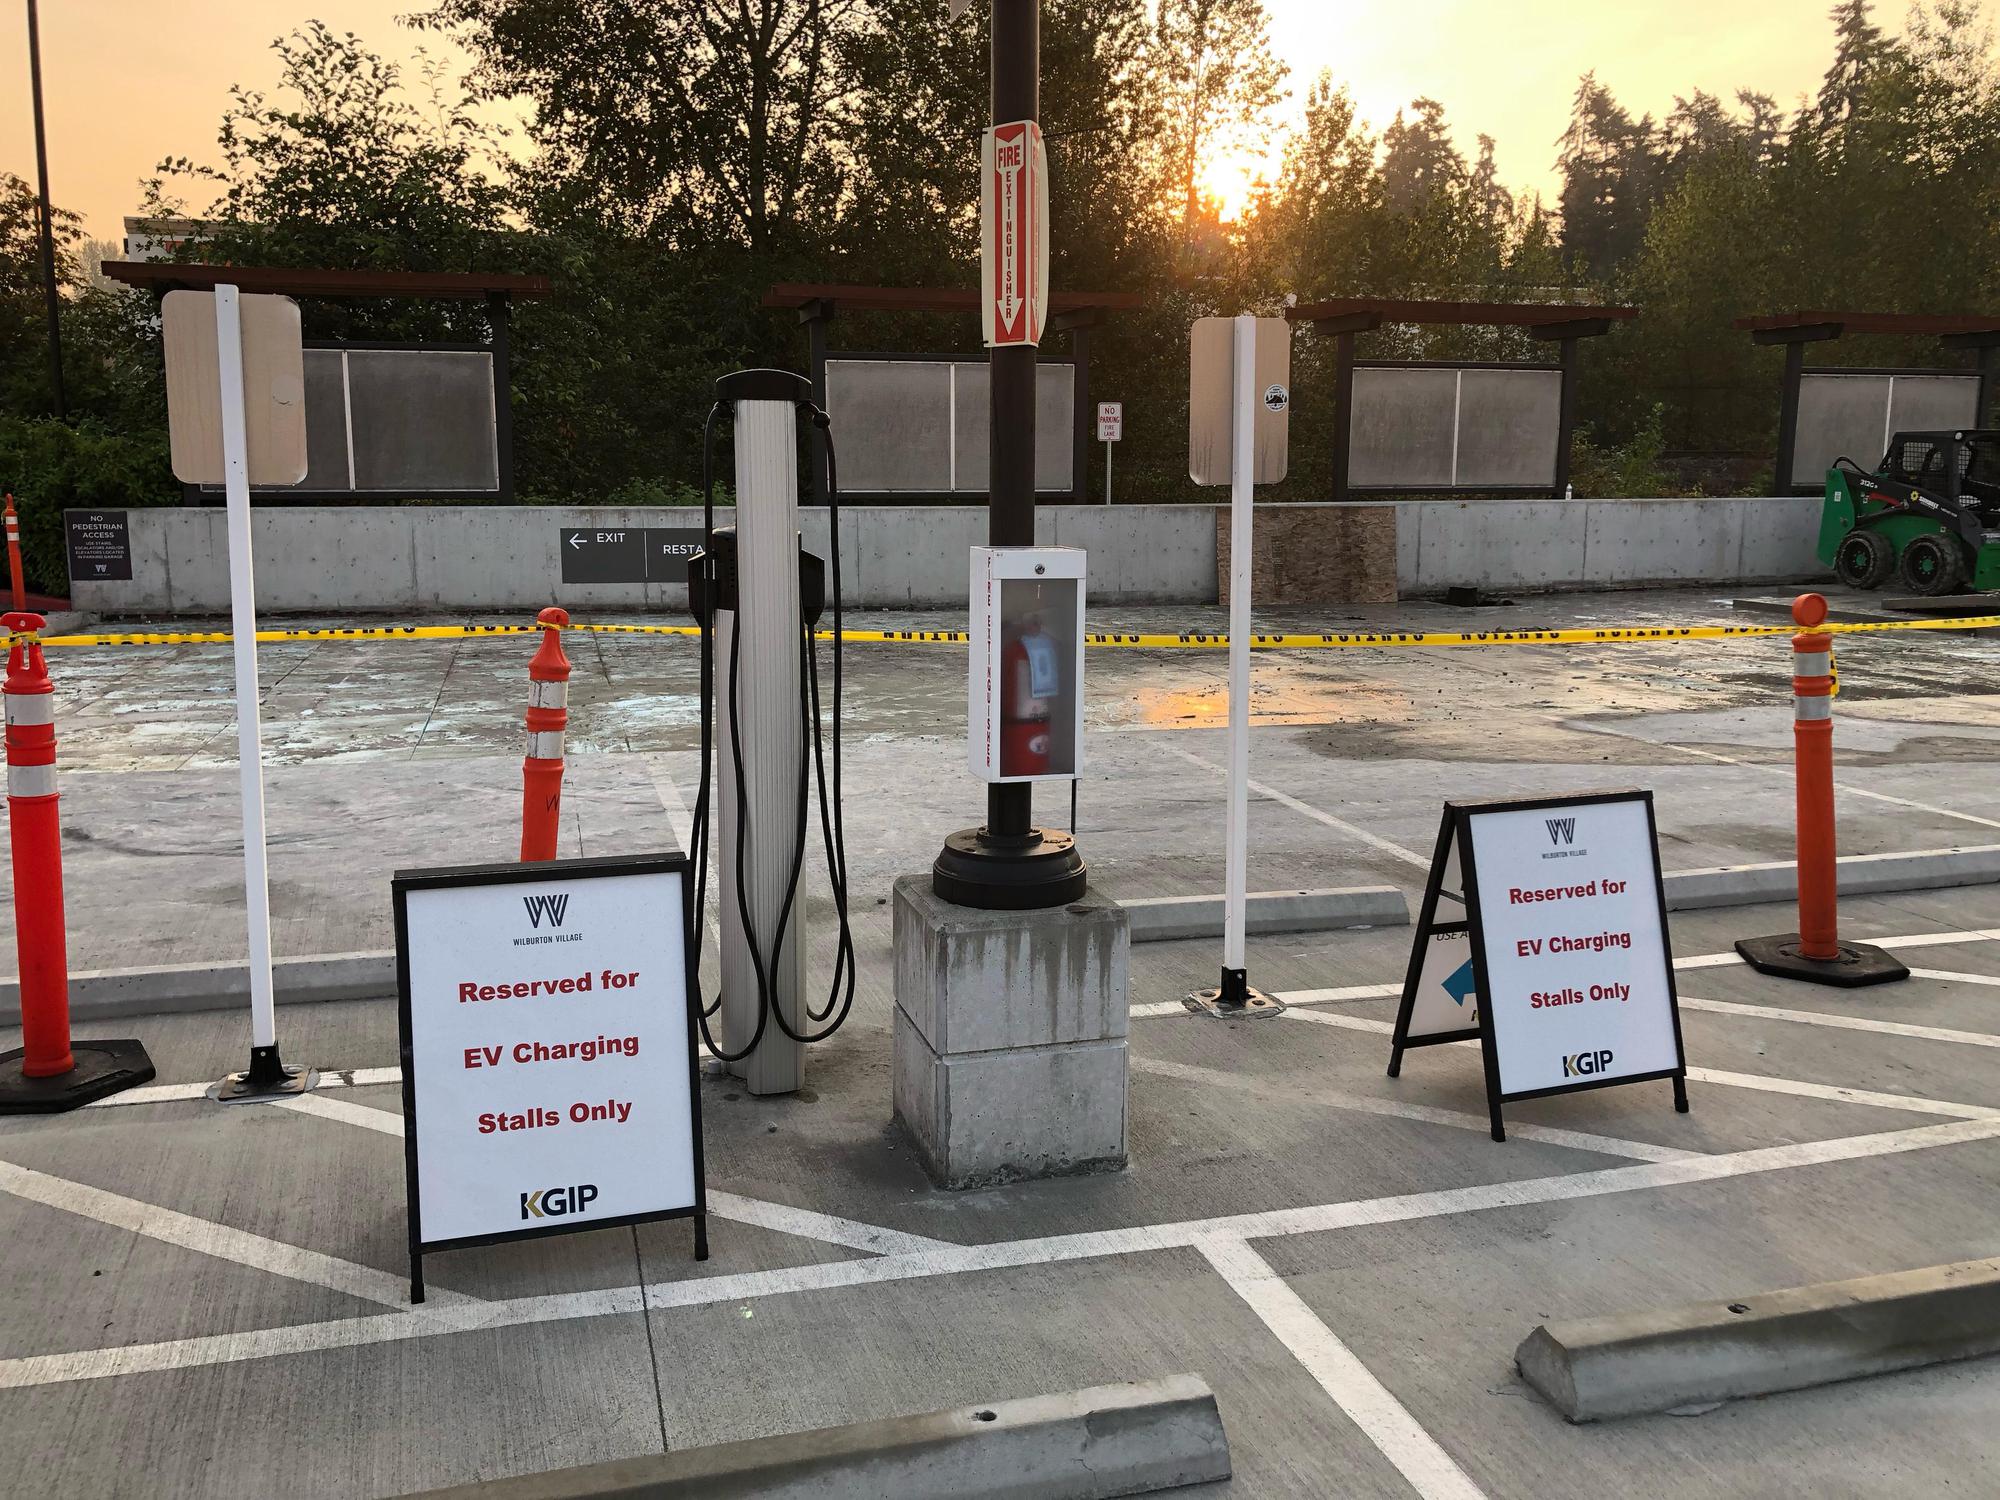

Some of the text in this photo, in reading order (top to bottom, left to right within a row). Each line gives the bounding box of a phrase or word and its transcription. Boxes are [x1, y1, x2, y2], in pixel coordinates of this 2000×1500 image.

[998, 145, 1021, 168] FIRE
[1005, 170, 1013, 319] EXTINGUISHER
[1099, 416, 1120, 424] PARKING
[82, 531, 115, 539] ACCESS
[596, 532, 626, 543] EXIT
[663, 544, 704, 554] RESTA
[1509, 878, 1627, 905] Reserved for
[512, 932, 583, 946] WILBURTON VILLAGE
[1517, 931, 1632, 957] EV Charging
[458, 969, 640, 1003] Reserved for
[1530, 982, 1631, 1009] Stalls Only
[464, 1035, 640, 1069] EV Charging
[1562, 1049, 1614, 1078] KGIP
[478, 1099, 633, 1134] Stalls Only
[520, 1184, 598, 1220] KGIP
